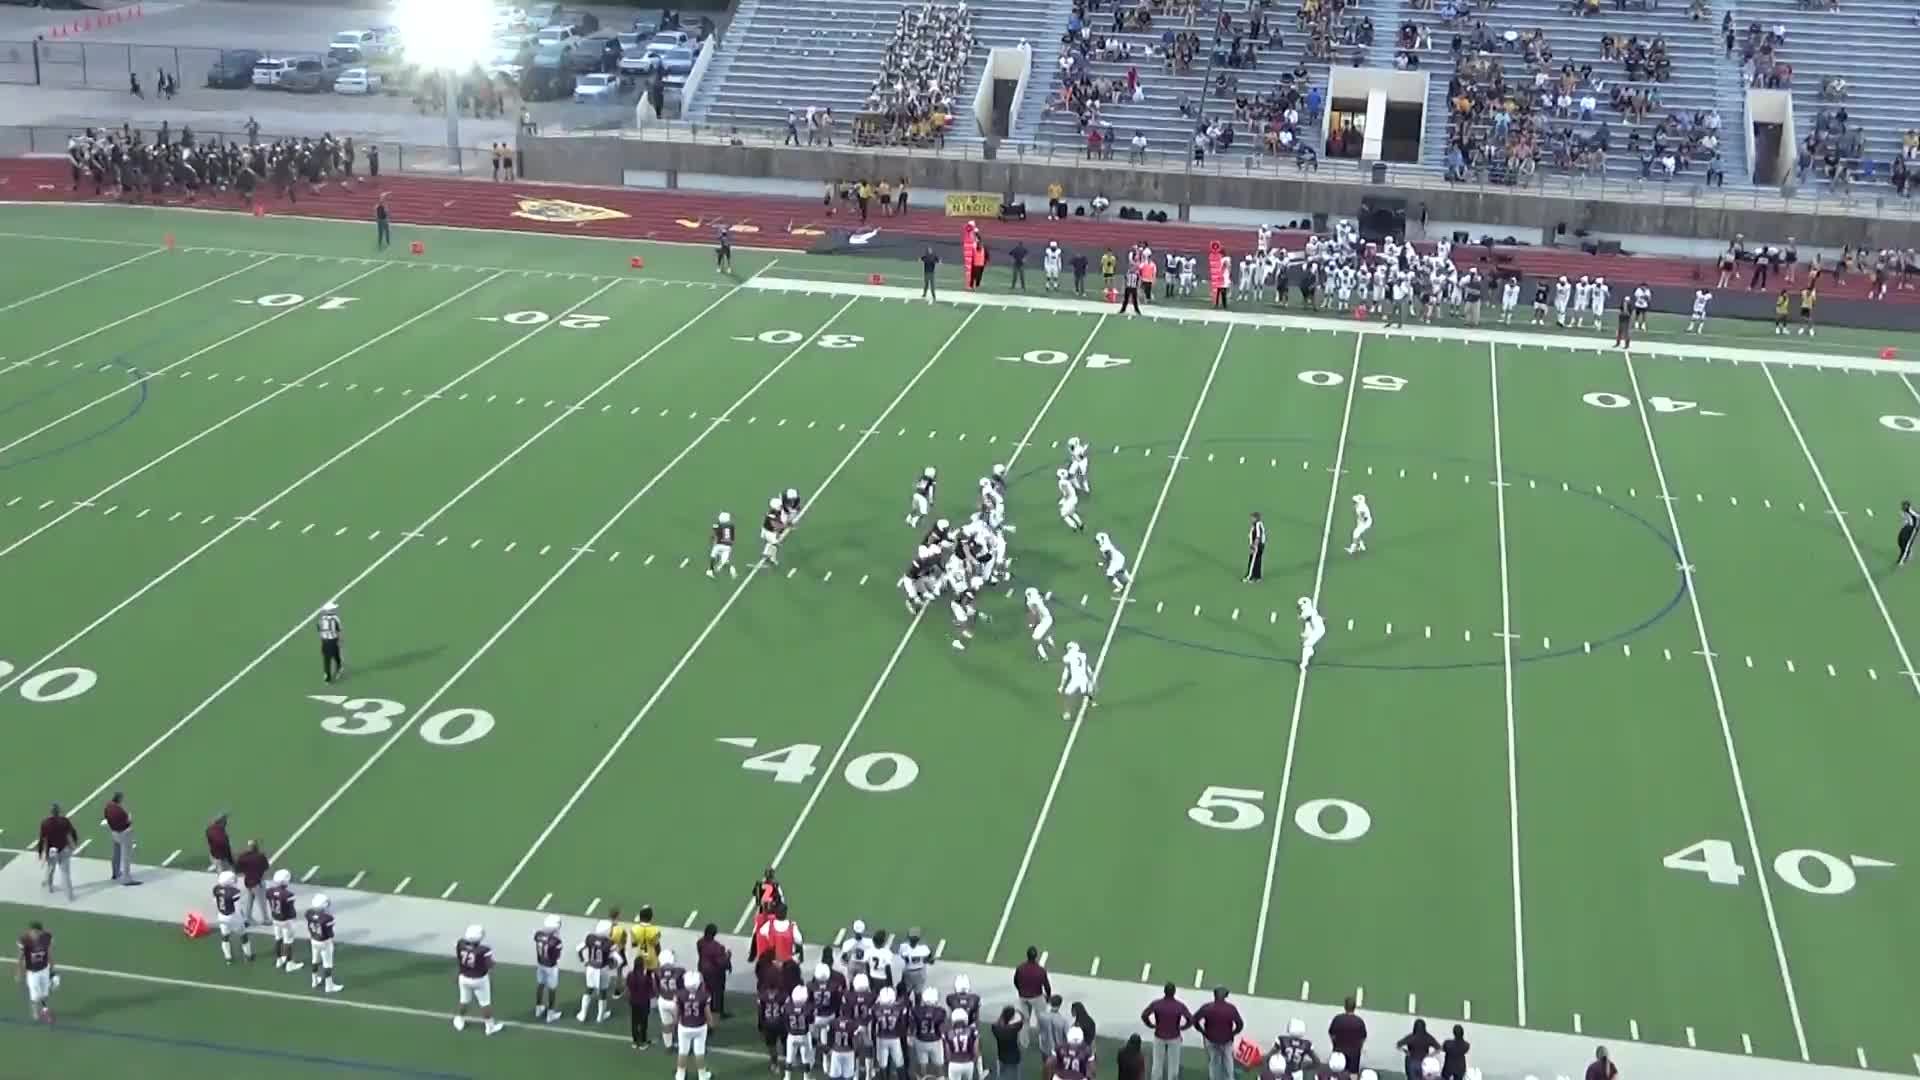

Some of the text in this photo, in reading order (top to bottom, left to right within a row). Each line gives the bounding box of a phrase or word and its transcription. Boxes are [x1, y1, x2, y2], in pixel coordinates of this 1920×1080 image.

[503, 310, 611, 329] 20
[758, 330, 864, 348] 30
[1023, 350, 1131, 368] 40
[1297, 370, 1409, 391] 50
[1583, 392, 1697, 412] 40
[0, 661, 97, 702] 0
[321, 698, 495, 745] 30
[742, 743, 919, 791] 40
[1188, 786, 1371, 840] 50
[1663, 839, 1856, 894] 40
[762, 884, 774, 902] 2
[953, 1035, 968, 1052] 17
[1238, 1042, 1253, 1063] 50
